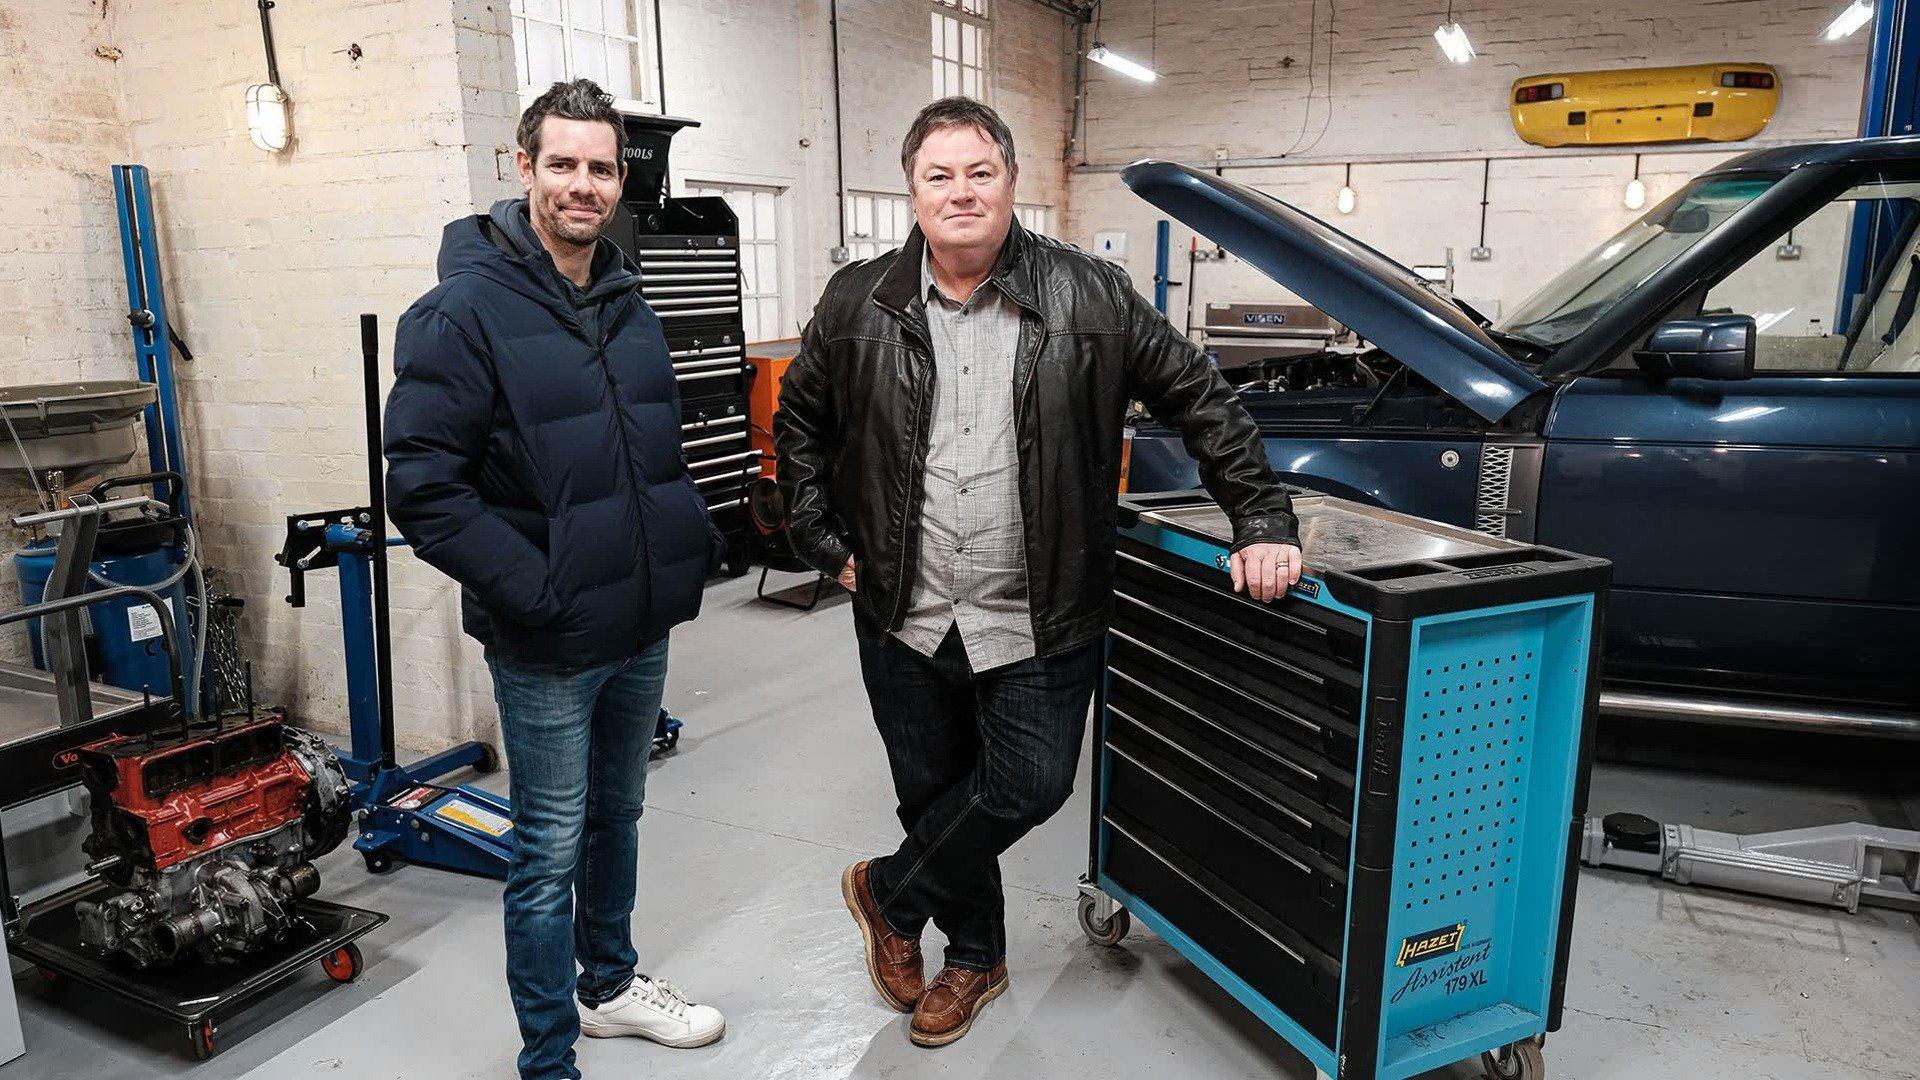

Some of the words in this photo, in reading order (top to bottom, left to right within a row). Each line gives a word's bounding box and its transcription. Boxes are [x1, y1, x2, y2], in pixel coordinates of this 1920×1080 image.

[622, 147, 653, 159] TOOLS
[1402, 930, 1460, 961] HAZET
[1391, 943, 1492, 1004] Assistent
[1445, 975, 1468, 995] 179
[1468, 969, 1488, 989] XL
